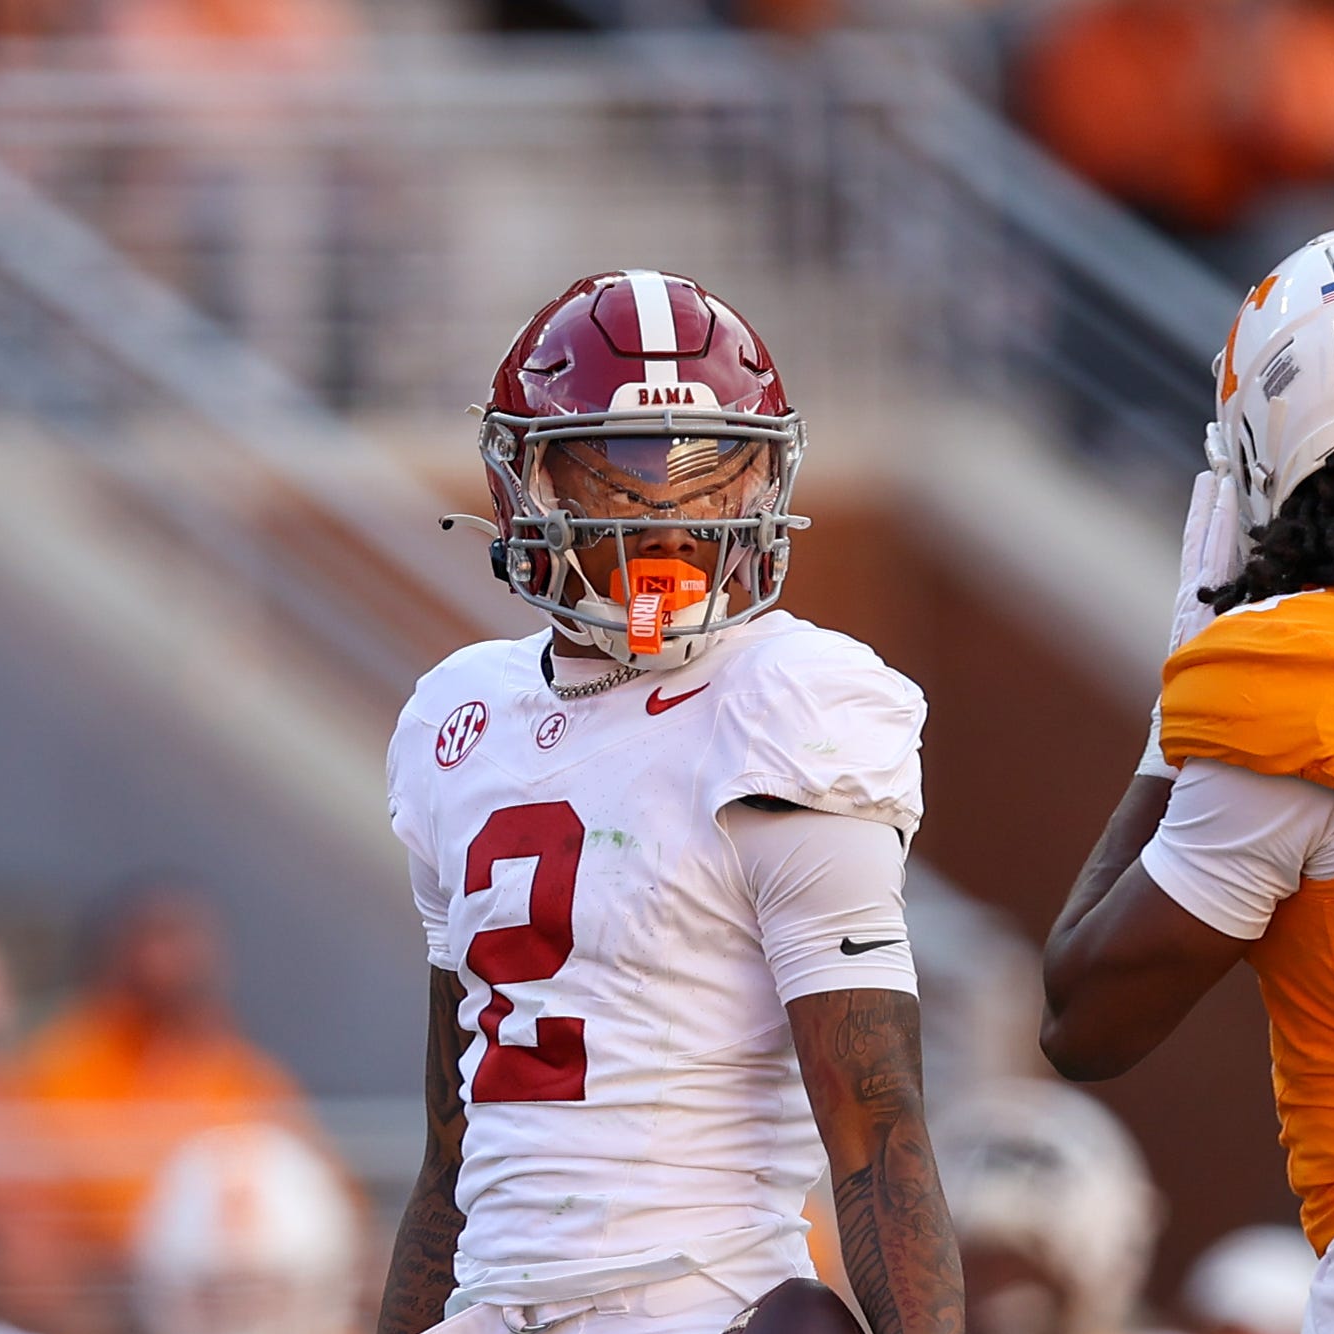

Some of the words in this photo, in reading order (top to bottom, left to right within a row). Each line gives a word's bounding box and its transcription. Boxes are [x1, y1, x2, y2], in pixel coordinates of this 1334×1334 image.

[638, 387, 695, 405] BAMA
[436, 702, 486, 764] SEC
[464, 800, 587, 1103] 2
